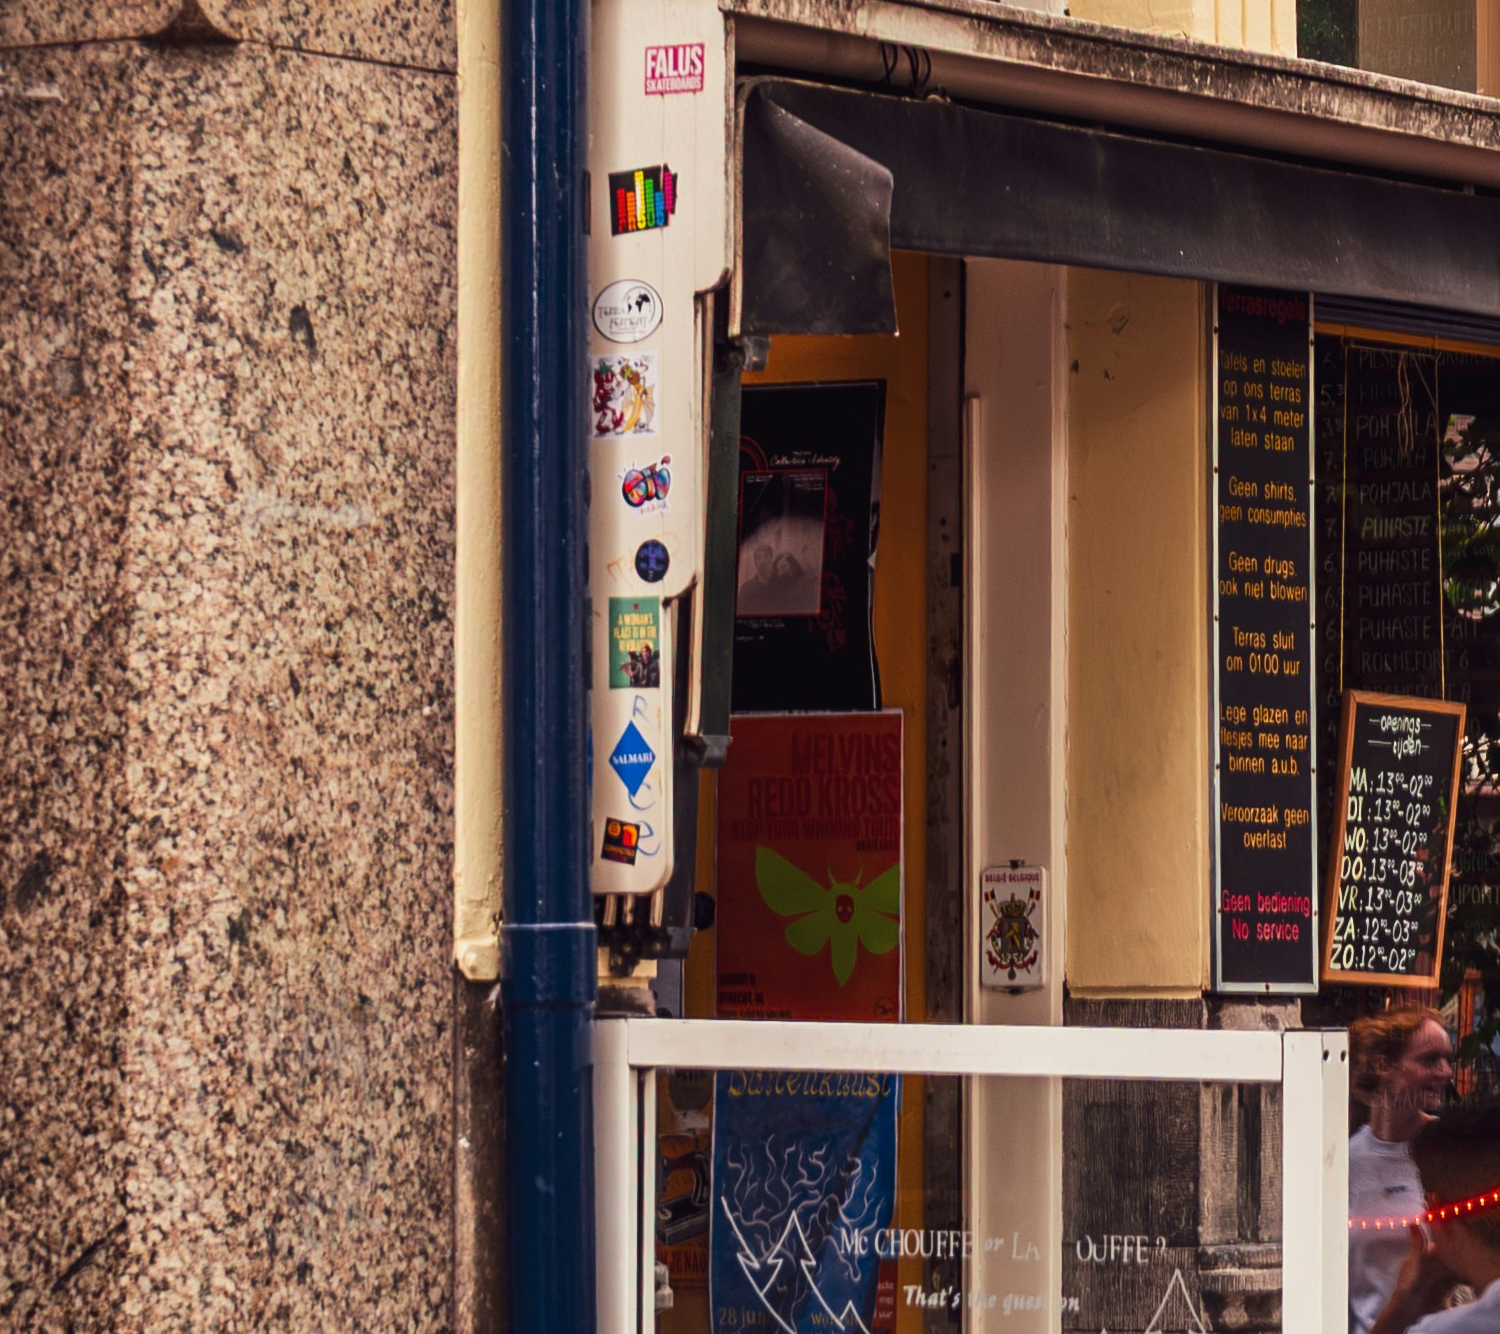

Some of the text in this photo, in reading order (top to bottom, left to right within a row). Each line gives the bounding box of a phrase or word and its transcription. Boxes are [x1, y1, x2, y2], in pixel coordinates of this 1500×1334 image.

[646, 45, 702, 77] FALUS
[1219, 285, 1306, 325] Terrasregels
[1220, 351, 1307, 378] Tafels en stoelen
[1223, 380, 1301, 404] op ons terras
[1220, 404, 1305, 429] van 1x4 meter
[1230, 426, 1295, 453] laten staan
[1228, 475, 1258, 497] Geen
[1219, 504, 1307, 530] geen consumpties
[1228, 551, 1258, 573] Geen
[1219, 579, 1308, 602] ook niet blowen
[1232, 626, 1295, 650] Terras sluit
[1226, 656, 1243, 671] om
[1282, 659, 1300, 675] uur
[1220, 703, 1308, 729] Lege glazen en
[1220, 727, 1308, 750] flesjes mee naar
[790, 731, 898, 776] MELVINS
[1229, 754, 1300, 775] binnen a.u.b.
[748, 775, 898, 817] REDD KROSS
[1220, 803, 1309, 830] Veroorzaak geen
[1243, 829, 1288, 850] overlast
[1221, 889, 1311, 919] Geen bediening
[1231, 918, 1300, 941] No service
[840, 1228, 868, 1256] Mc
[984, 1235, 1005, 1253] or
[902, 1284, 961, 1309] That's
[719, 1307, 738, 1324] 28
